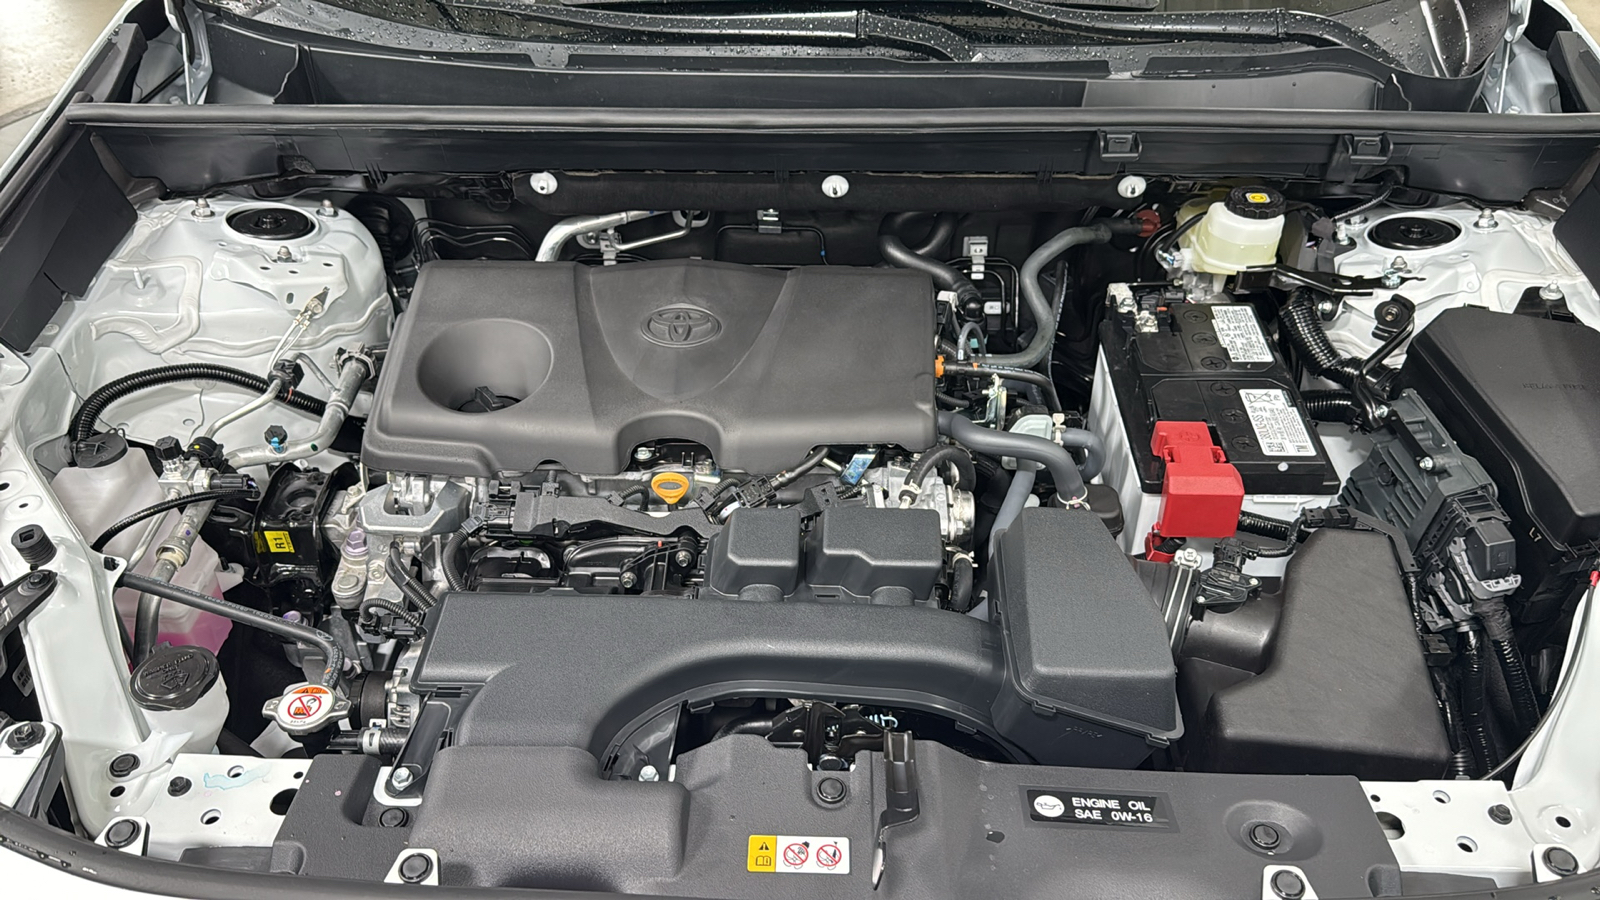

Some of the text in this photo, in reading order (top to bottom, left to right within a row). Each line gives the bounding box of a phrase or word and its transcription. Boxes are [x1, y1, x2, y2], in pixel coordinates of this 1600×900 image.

[272, 537, 286, 549] R1
[1071, 796, 1151, 812] ENGINE OIL
[1074, 808, 1153, 823] SAE 0W-16
